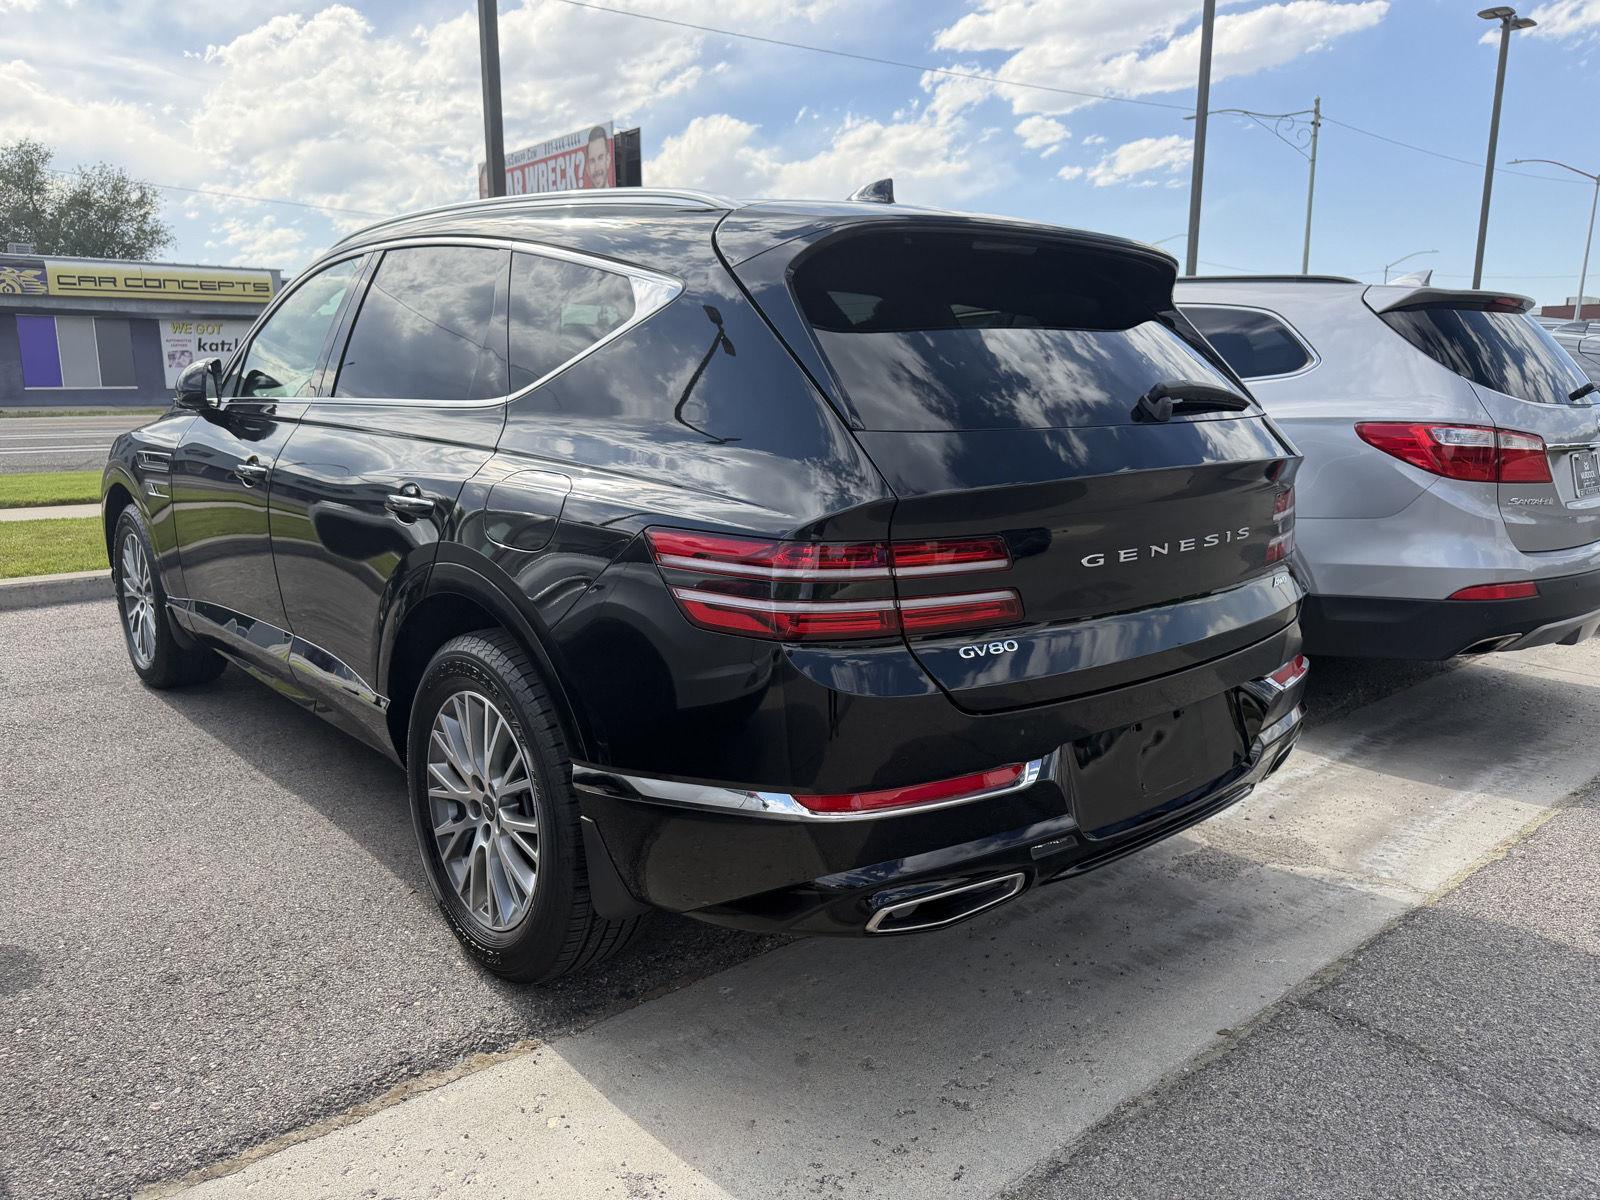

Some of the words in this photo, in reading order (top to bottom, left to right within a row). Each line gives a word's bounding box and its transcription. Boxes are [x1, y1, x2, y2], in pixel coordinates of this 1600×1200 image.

[505, 170, 522, 196] AR
[525, 151, 585, 194] WRECK?
[57, 275, 117, 288] CAR
[124, 277, 270, 292] CONCEPTS
[170, 321, 192, 335] WE
[196, 322, 223, 336] GOT
[1081, 527, 1250, 567] GENESIS
[958, 640, 1019, 660] GV80
